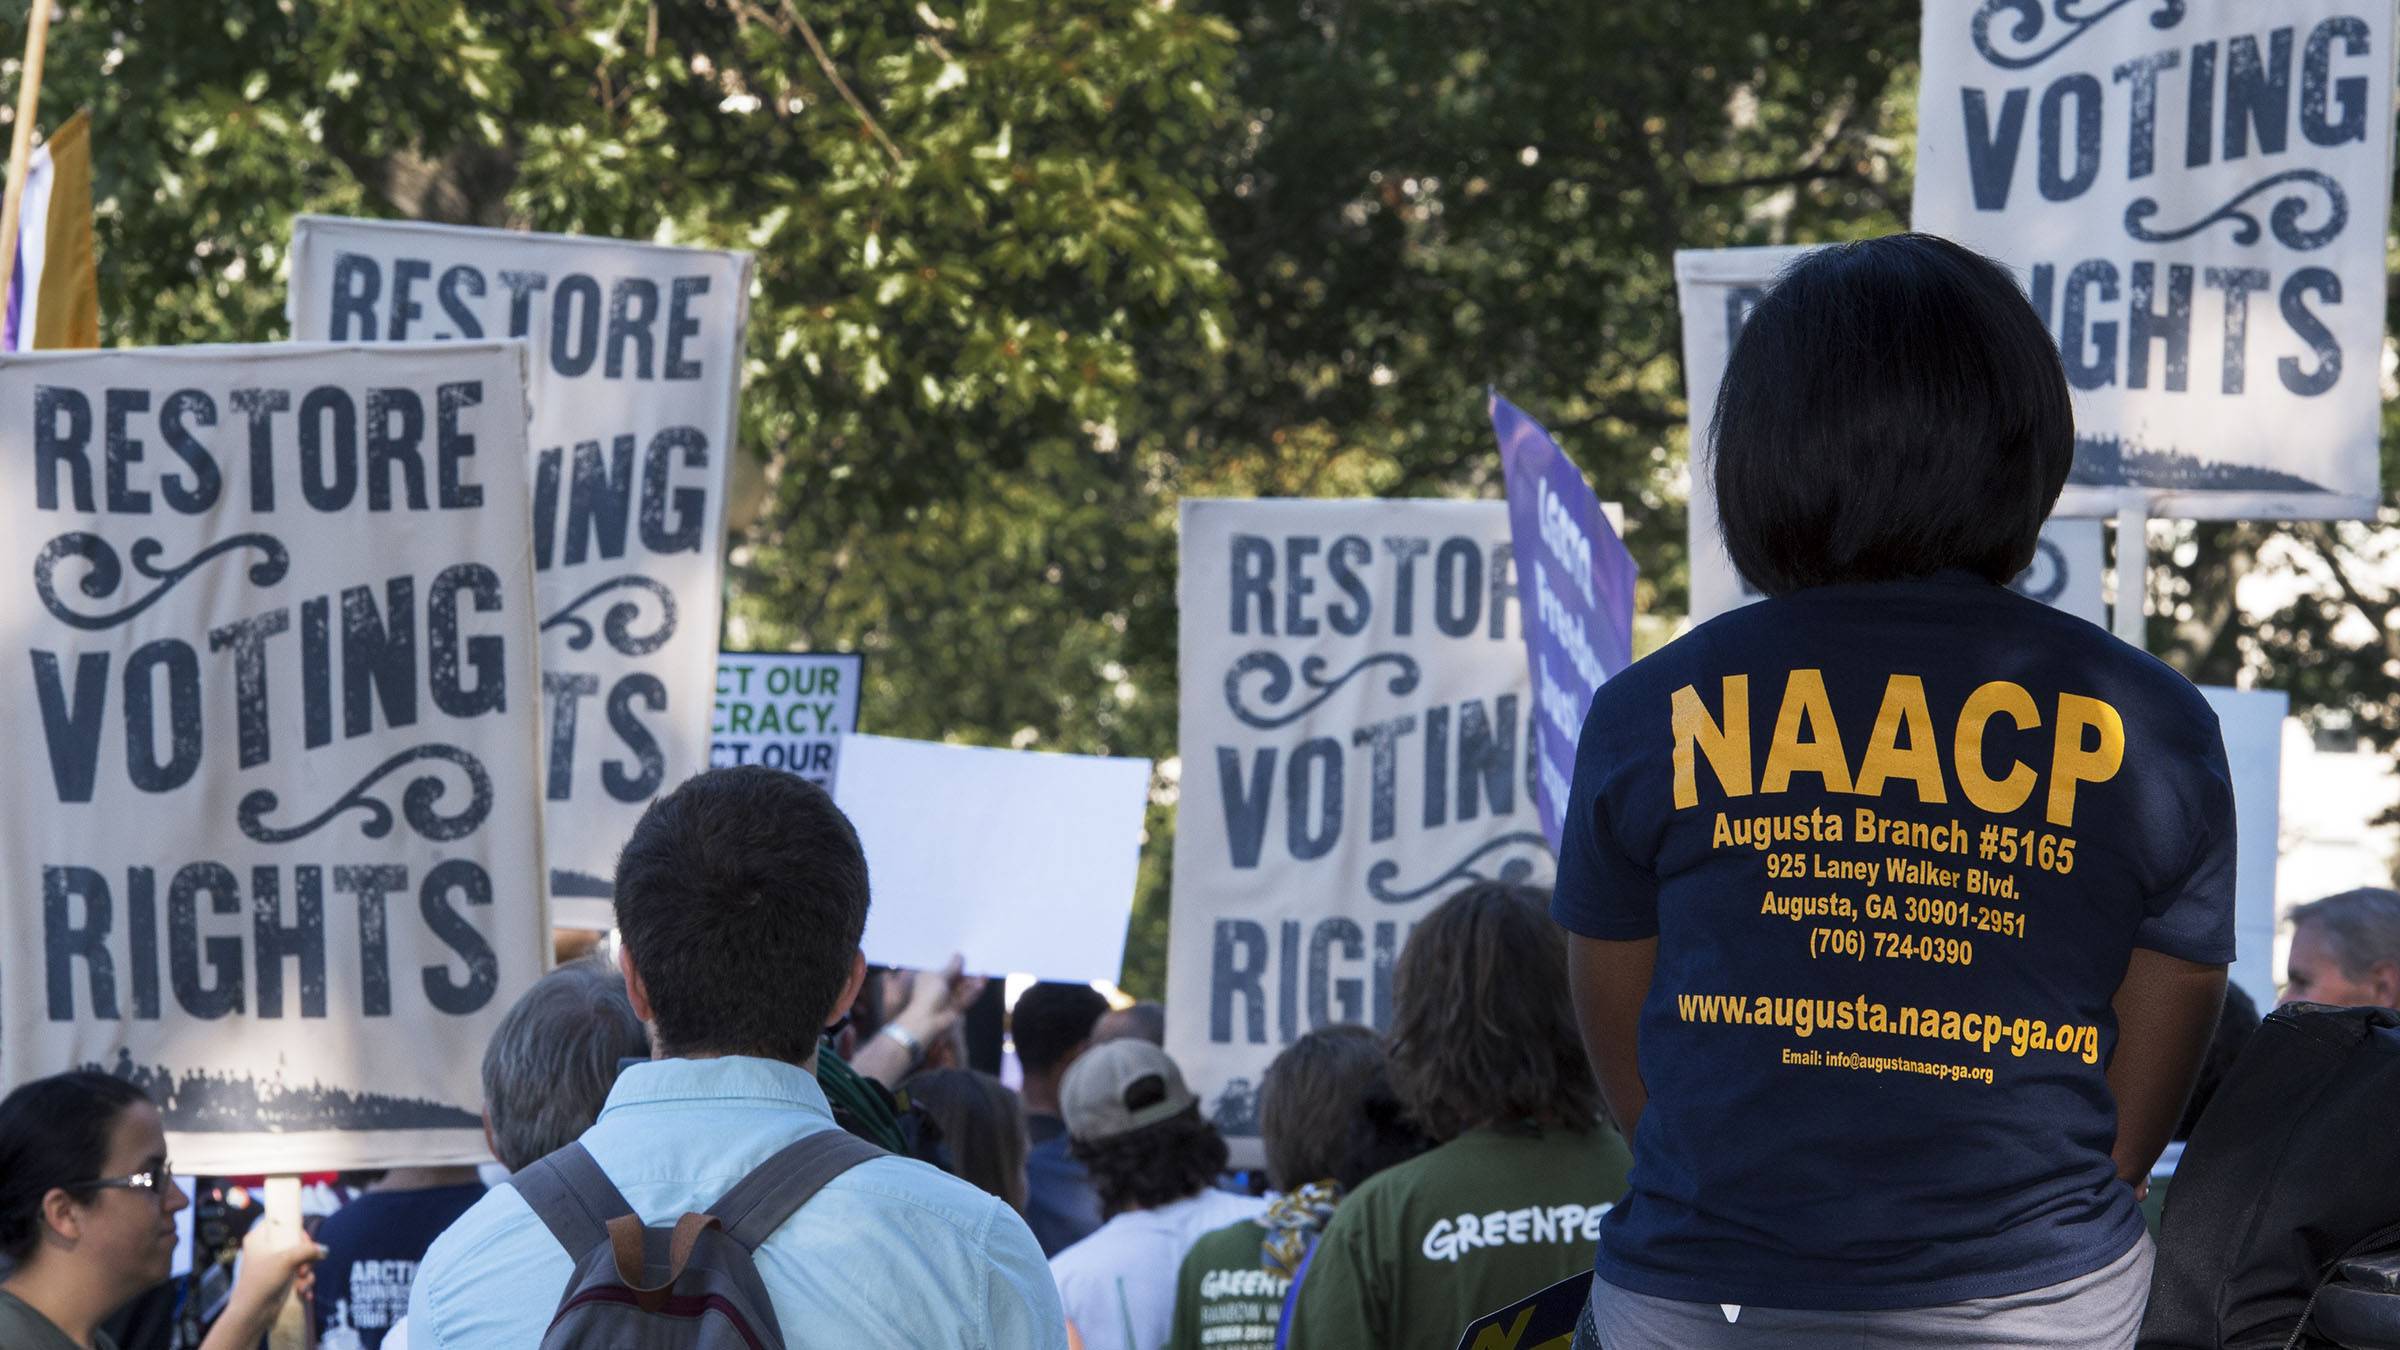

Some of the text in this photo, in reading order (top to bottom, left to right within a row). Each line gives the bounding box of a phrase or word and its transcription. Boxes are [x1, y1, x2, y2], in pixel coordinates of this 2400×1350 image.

[1959, 14, 2372, 212] VOTING
[329, 251, 711, 381] RESTORE
[34, 380, 485, 515] RESTORE
[534, 425, 709, 572] ING
[1229, 535, 1524, 640] RESTOR
[30, 562, 507, 803] VOTING
[766, 665, 840, 695] OUR
[712, 702, 838, 734] CRACY.
[1670, 668, 2126, 827] NAACP
[762, 743, 832, 771] OUR
[1216, 694, 1538, 870] VOTIN
[1712, 806, 2077, 875] Augusta Branch #5165
[1766, 853, 2020, 900] 925 Laney Walker Blvd.
[42, 858, 500, 1022] RIGHTS
[1761, 891, 2027, 938] Augusta, GA 30901-2951
[1809, 927, 1973, 966] (706) 724-0390
[1678, 993, 2099, 1065] www.augusta.naacp-ga.org
[1782, 1048, 1994, 1085] Email: info@augustanaacp-ga.org
[1422, 1202, 1615, 1262] GREENPE
